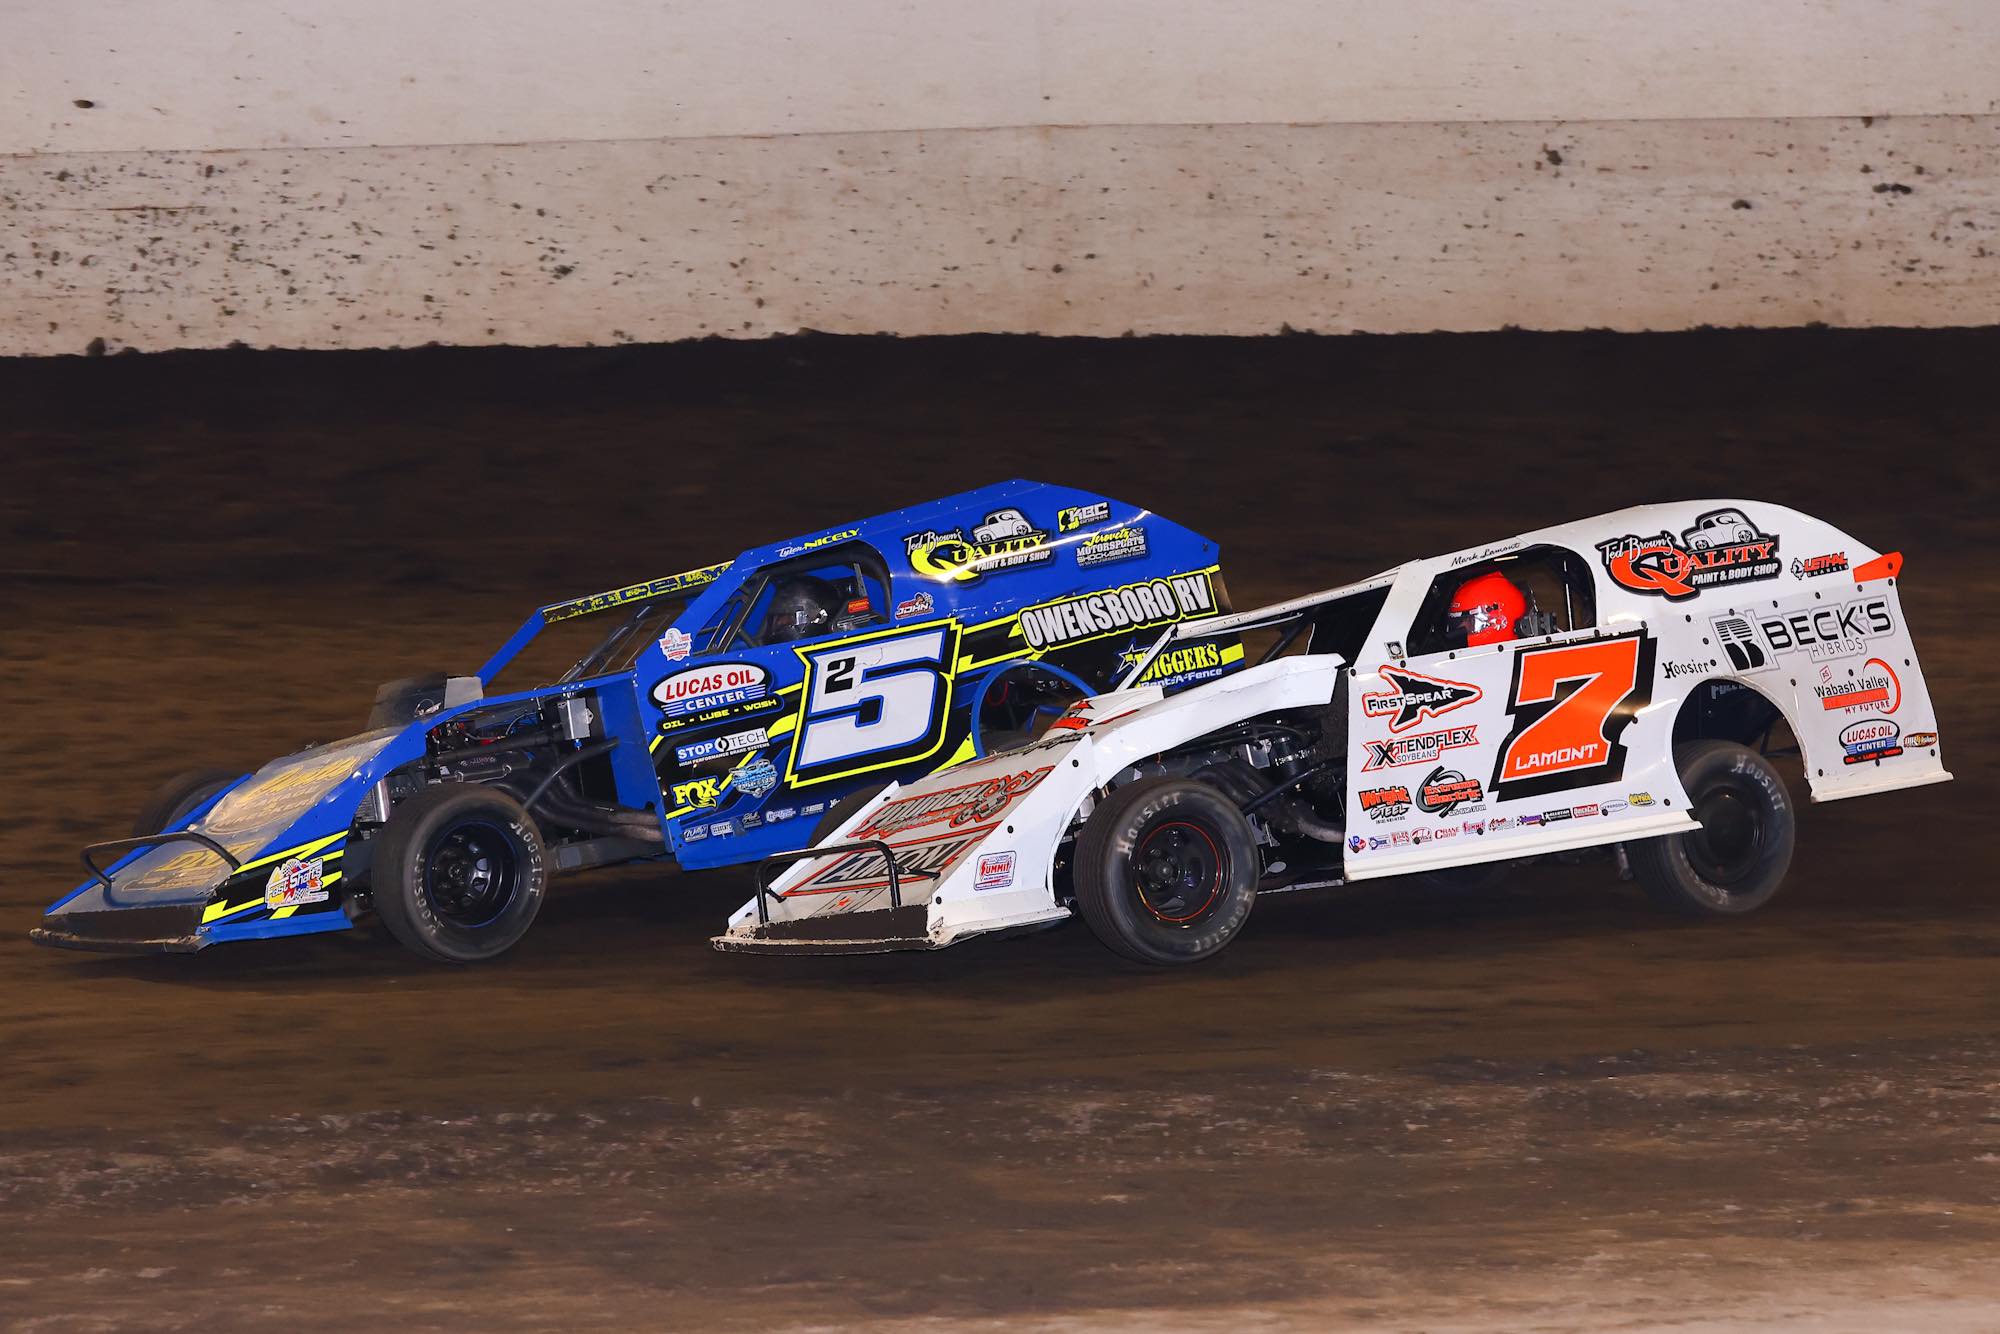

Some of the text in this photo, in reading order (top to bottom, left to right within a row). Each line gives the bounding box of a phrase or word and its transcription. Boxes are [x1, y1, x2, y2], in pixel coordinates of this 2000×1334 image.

[1068, 502, 1108, 521] KBC
[1716, 515, 1739, 525] Q
[775, 528, 860, 558] Tyler NICELY
[904, 528, 963, 556] Ted Brown's
[1076, 535, 1145, 557] MOTORSPORTS
[1600, 534, 1675, 565] Ted Brown's
[911, 534, 1046, 581] QUALITY
[977, 550, 1051, 572] PAINT & BODY SHOP
[1451, 542, 1520, 567] Mark Lamont
[1804, 552, 1848, 572] LETHAL
[1611, 541, 1775, 596] QUALITY
[1692, 562, 1778, 586] PAINT & BODY SHOP
[896, 603, 929, 615] JOHN
[1020, 574, 1211, 647] OWENSBORO RV
[1761, 601, 1892, 650] BECK'S
[1811, 637, 1864, 657] HYBRIDS
[825, 657, 856, 694] 2
[1662, 659, 1710, 680] Hoosier
[665, 670, 756, 700] LUCAS OIL
[1814, 676, 1889, 698] Wabash Valley
[686, 691, 745, 711] CENTER
[800, 631, 943, 767] 5
[1499, 636, 1641, 783] 7
[1845, 700, 1890, 715] MY FUTURE
[663, 699, 777, 730] OIL LUBE WASH
[1847, 725, 1893, 743] LUCAS OIL
[677, 731, 765, 760] STOP TECH
[1377, 730, 1472, 767] XTENDFLEX
[1397, 749, 1437, 762] SOYBEANS
[1515, 743, 1598, 770] LAMONT
[1856, 740, 1887, 752] CENTER
[693, 751, 730, 764] PERFORMANCE
[673, 778, 720, 808] FOX
[1360, 787, 1410, 808] Wright
[1424, 780, 1479, 795] Extreme
[1425, 789, 1481, 806] Electric
[1370, 804, 1410, 820] STEEL
[981, 861, 1011, 876] SUMMIT
[268, 881, 288, 900] Fast
[290, 866, 321, 889] Shafts
